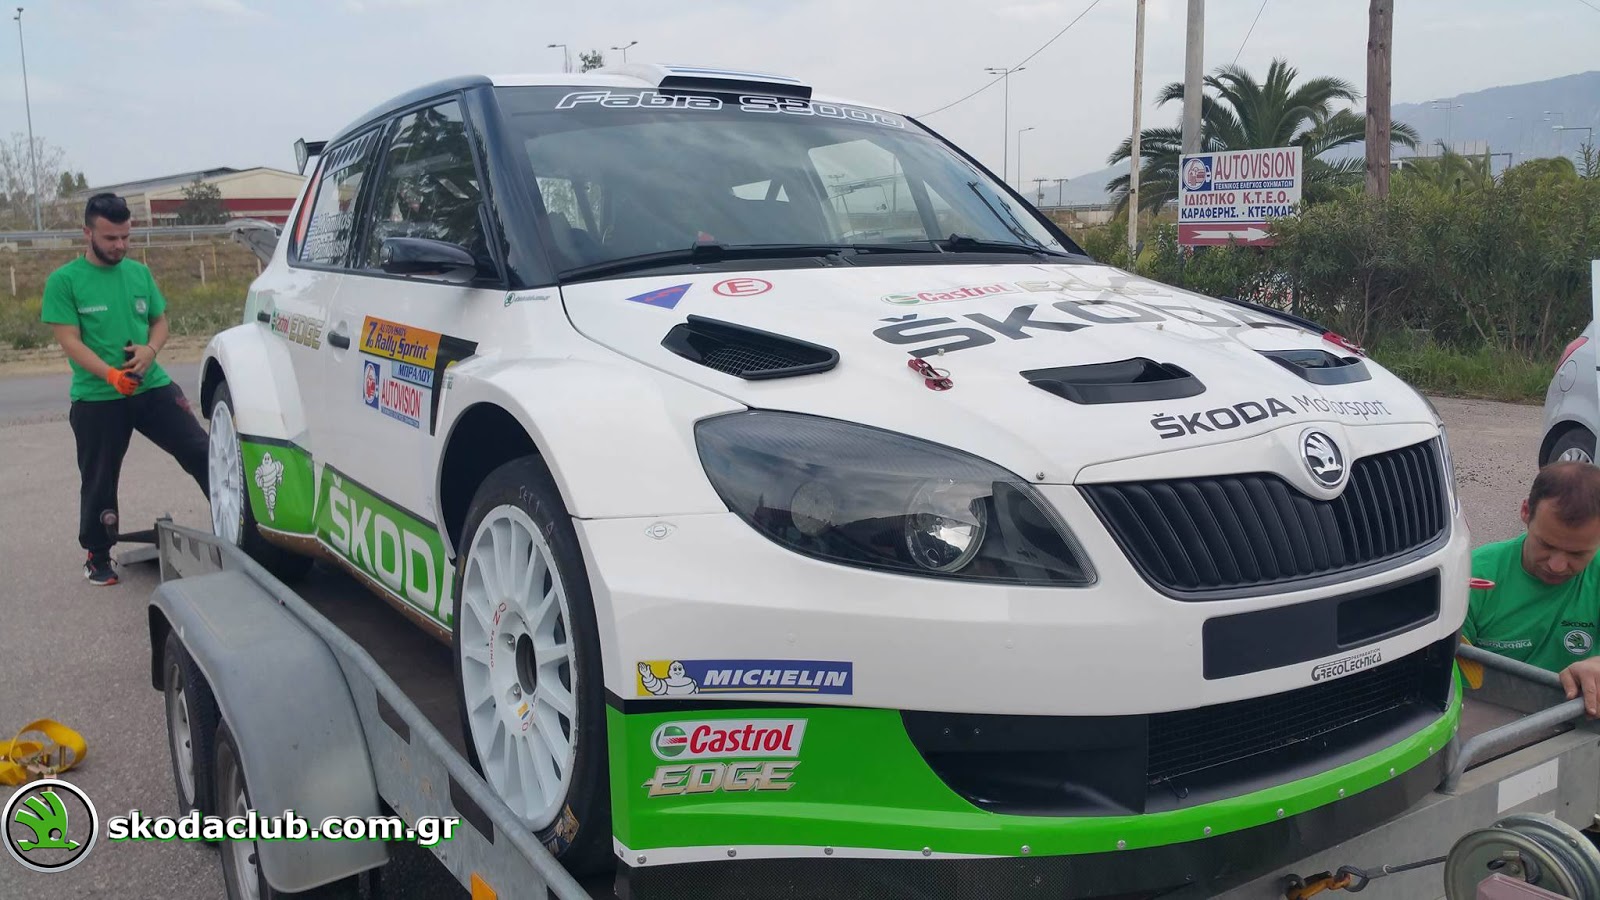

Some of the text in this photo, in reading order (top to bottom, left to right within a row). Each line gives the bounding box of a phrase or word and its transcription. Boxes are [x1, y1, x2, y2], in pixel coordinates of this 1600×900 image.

[555, 90, 905, 129] Fabia S2000
[1214, 151, 1296, 181] AUTOVISION
[1184, 190, 1290, 206] ΙΔΙΩΤΙΚΟ Κ.Τ.Ε.Ο.
[1262, 180, 1293, 188] ΟΧΗΜΑΤΩΝ
[725, 280, 759, 294] E
[916, 283, 1010, 302] Castrol
[374, 332, 429, 361] Rally Sprint
[381, 378, 421, 419] AUTOVISION
[1150, 394, 1392, 440] ŠKODA Motorsport
[703, 669, 848, 687] MICHELIN
[689, 724, 795, 754] Castrol
[641, 761, 801, 798] EDGE
